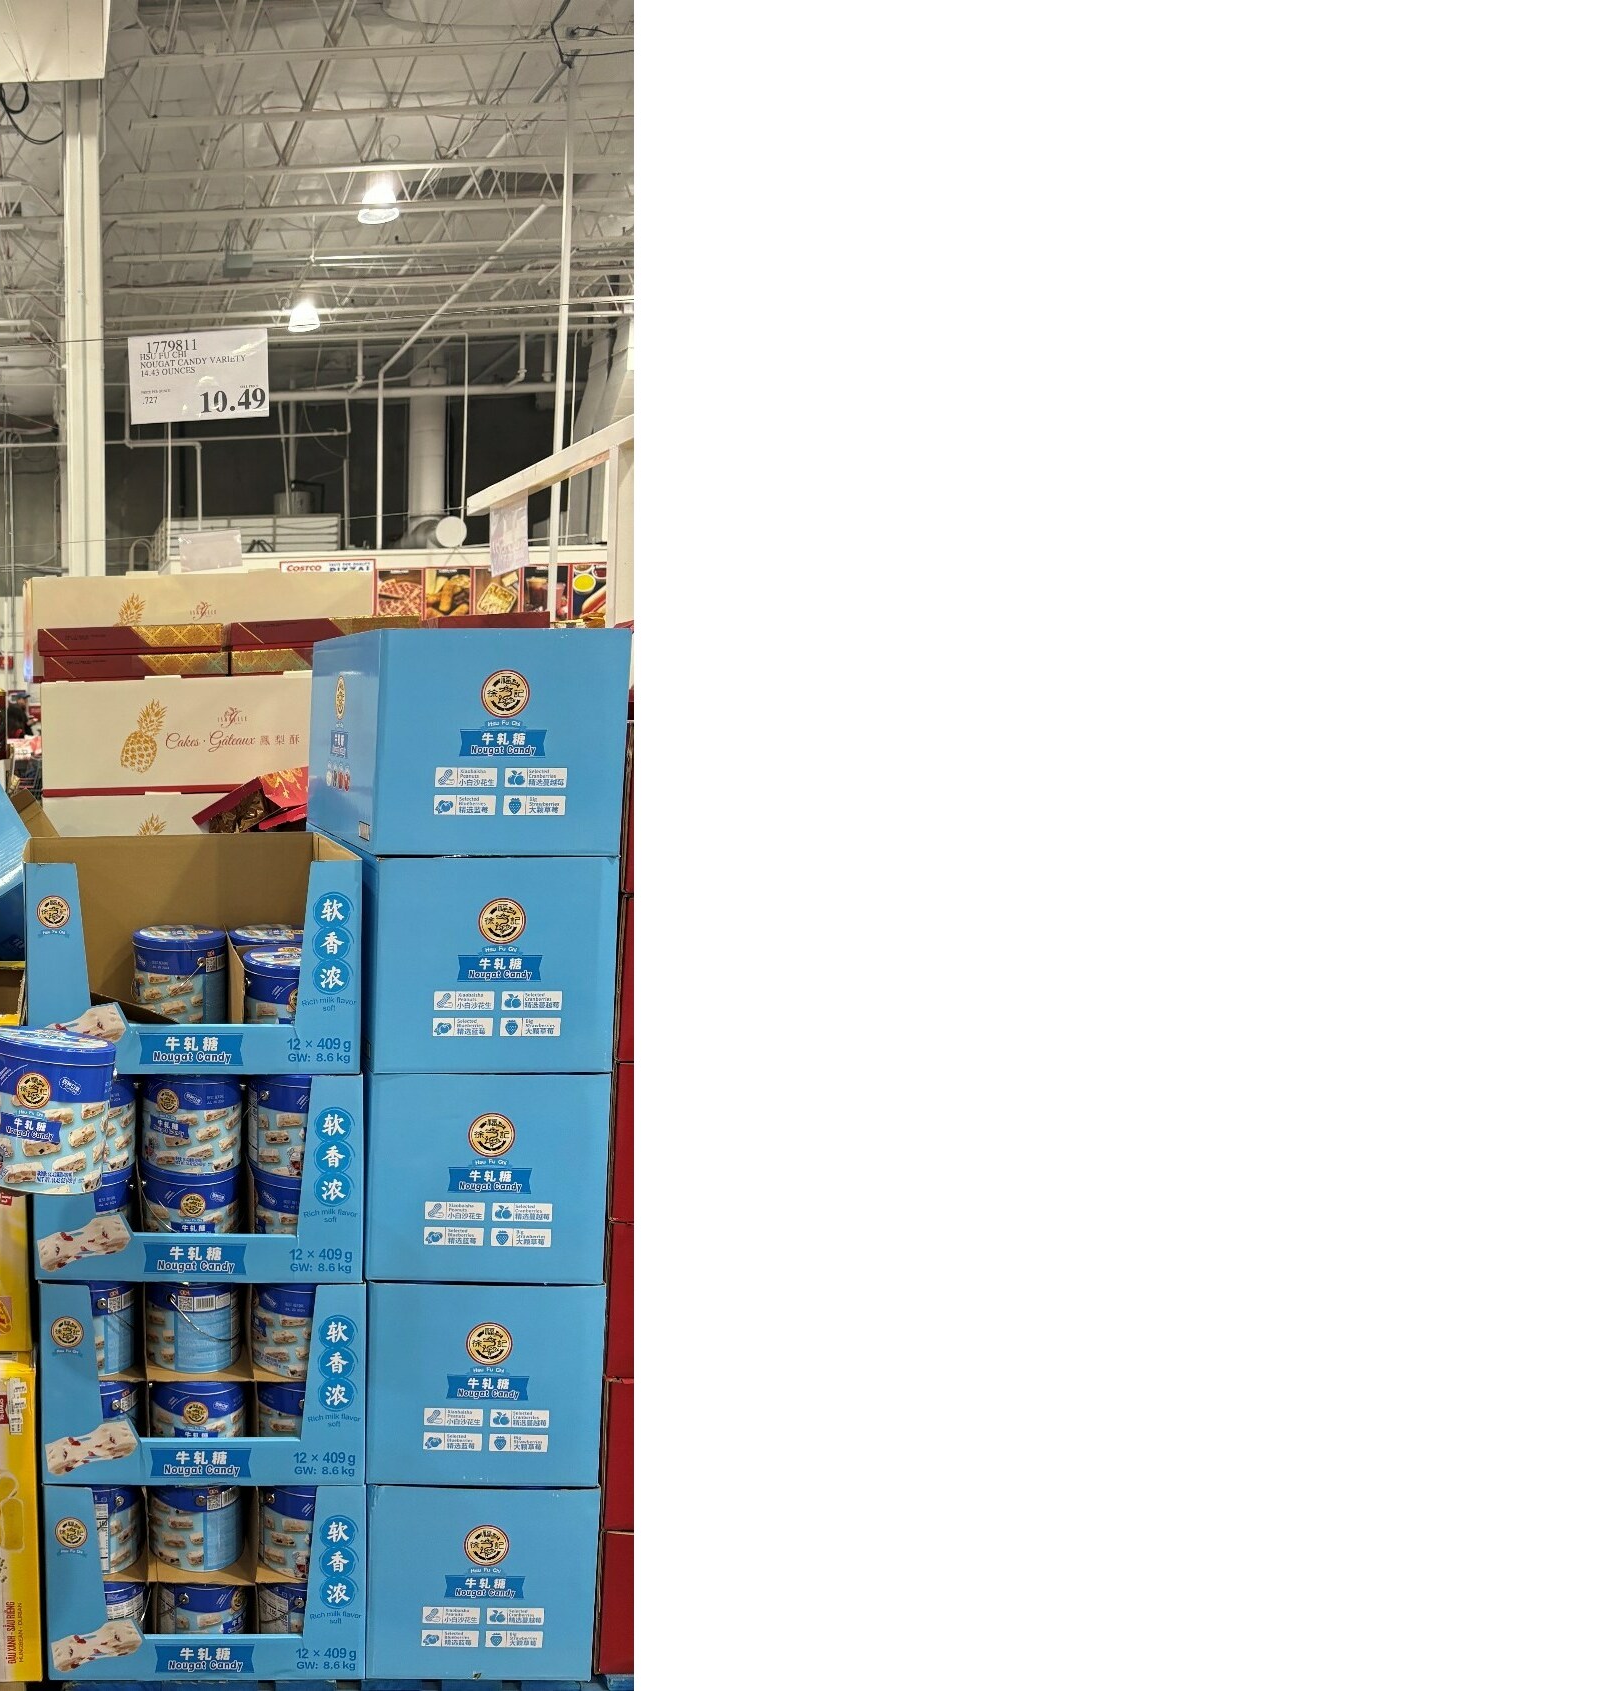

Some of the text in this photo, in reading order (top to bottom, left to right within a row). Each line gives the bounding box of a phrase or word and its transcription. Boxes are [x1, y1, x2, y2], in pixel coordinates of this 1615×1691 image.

[147, 339, 197, 353] 1779811
[140, 355, 246, 369] NOUGAT CANDY VARIETY
[141, 367, 195, 377] 14.43 OUNCES
[142, 396, 158, 404] .727
[200, 388, 266, 414] 10.49
[287, 564, 322, 572] COSTCO
[165, 733, 201, 750] Cakes
[207, 730, 256, 753] Gâteaux
[481, 732, 526, 746] 牛轧糖
[471, 745, 536, 757] Nougat Candy
[320, 899, 345, 989] 软香浓
[478, 957, 523, 970] 牛轧糖
[468, 970, 533, 981] Nougat Candy
[302, 997, 318, 1007] Rich
[336, 996, 357, 1005] flavor
[165, 1036, 219, 1051] 牛轧糖
[287, 1038, 301, 1051] 12
[316, 1037, 341, 1050] 409
[152, 1051, 232, 1063] Nougat Candy
[288, 1052, 351, 1064] GW: 8.6 kg
[13, 1118, 47, 1132] 牛轧糖
[321, 1113, 347, 1201] 软香浓
[469, 1170, 513, 1183] 牛轧糖
[458, 1181, 522, 1193] Nougat Candy
[303, 1210, 320, 1218] Rich
[337, 1209, 358, 1218] flavor
[169, 1246, 222, 1261] 牛轧糖
[289, 1249, 303, 1261] 12
[319, 1248, 343, 1261] 409
[157, 1260, 236, 1274] Nougat Candy
[290, 1263, 352, 1274] GW: 8.6 kg
[325, 1321, 350, 1406] 软香浓
[467, 1377, 510, 1390] 牛轧糖
[457, 1389, 520, 1400] Nougat Candy
[175, 1450, 228, 1465] 牛轧糖
[293, 1452, 307, 1464] 12
[322, 1451, 346, 1464] 409
[163, 1464, 240, 1477] Nougat Candy
[294, 1466, 355, 1477] GW: 8.6 kg
[326, 1521, 351, 1604] 软香浓
[465, 1577, 507, 1590] 牛轧糖
[454, 1588, 516, 1599] Nougat Candy
[6, 1635, 17, 1652] XANH
[179, 1647, 231, 1661] 牛轧糖
[295, 1648, 309, 1659] 12
[323, 1647, 347, 1659] 409
[167, 1660, 244, 1673] Nougat Candy
